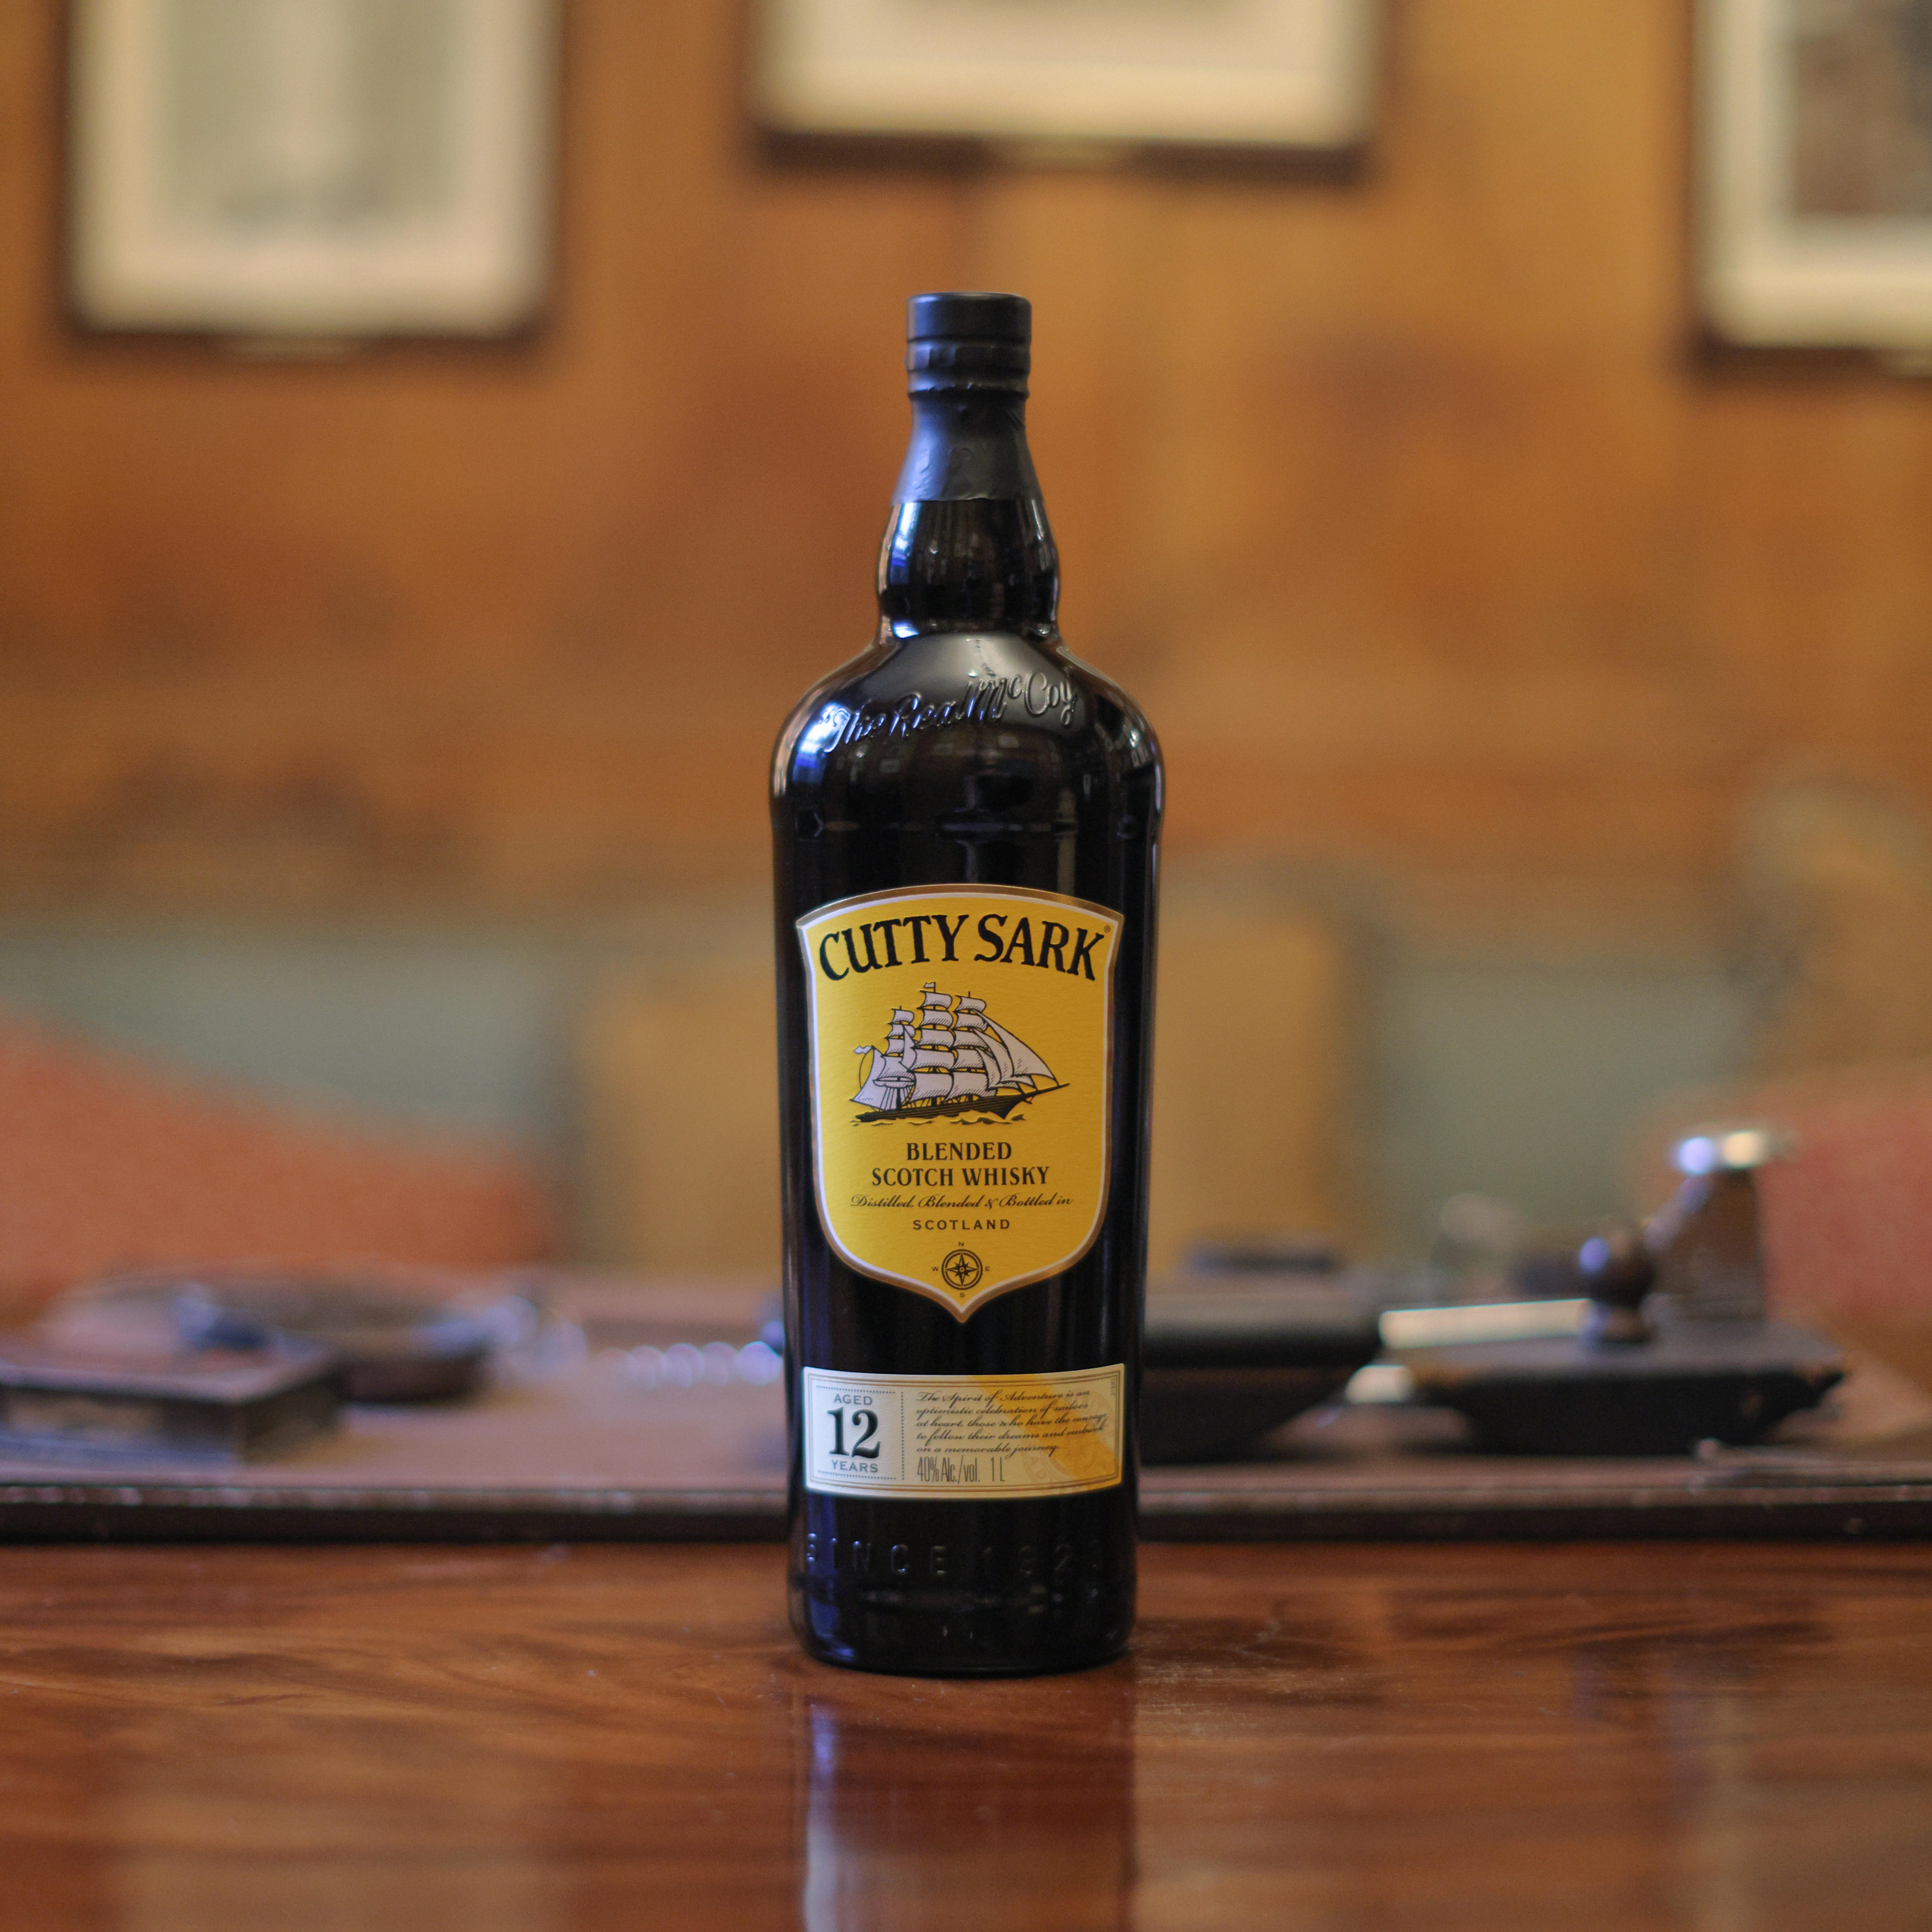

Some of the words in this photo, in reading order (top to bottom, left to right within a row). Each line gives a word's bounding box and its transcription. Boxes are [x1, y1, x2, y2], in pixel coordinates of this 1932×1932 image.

[819, 914, 969, 981] CUTTY
[975, 913, 1104, 981] SARK
[906, 1142, 1012, 1161] BLENDED
[871, 1167, 954, 1187] SCOTCH
[962, 1166, 1050, 1185] WHISKY
[850, 1194, 914, 1208] Distilled,
[918, 1195, 982, 1208] Blended
[985, 1198, 998, 1209] &
[999, 1193, 1054, 1207] Bottled
[1057, 1193, 1073, 1205] in
[913, 1219, 1010, 1230] SCOTLAND
[834, 1393, 873, 1405] AGED
[915, 1390, 942, 1401] The
[942, 1392, 983, 1409] Spirit
[984, 1389, 1003, 1408] of
[1000, 1391, 1063, 1401] Adventure
[916, 1407, 973, 1421] optimistic
[976, 1404, 1037, 1414] celebration
[1040, 1400, 1057, 1420] of
[1053, 1400, 1088, 1412] sailors
[967, 1415, 996, 1427] those
[999, 1414, 1023, 1426] who
[1026, 1413, 1052, 1426] have
[1054, 1412, 1070, 1424] the
[827, 1406, 881, 1459] 12
[925, 1427, 965, 1447] follow
[968, 1428, 995, 1439] their
[998, 1430, 1039, 1439] dreams
[1042, 1427, 1067, 1438] and
[944, 1442, 1011, 1452] memorable
[831, 1460, 878, 1472] YEARS
[917, 1455, 939, 1483] 40%
[991, 1456, 994, 1482] 1
[1000, 1456, 1006, 1482] L
